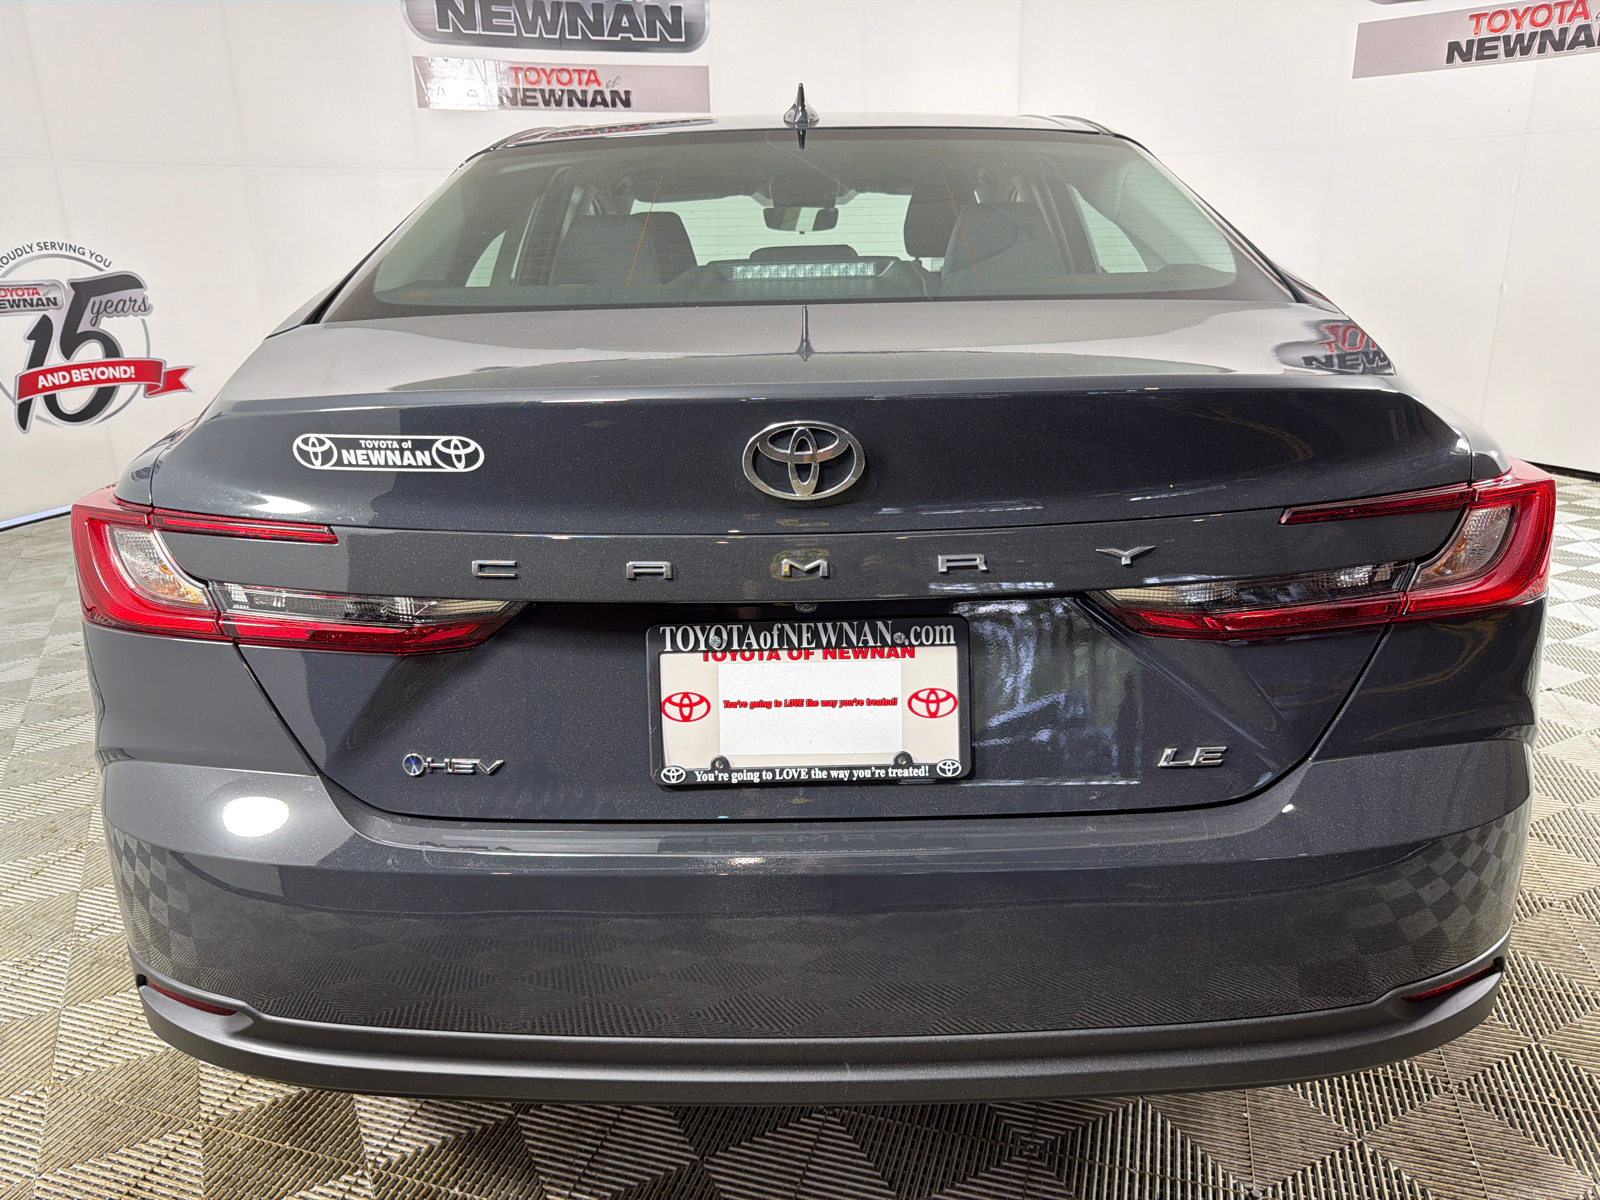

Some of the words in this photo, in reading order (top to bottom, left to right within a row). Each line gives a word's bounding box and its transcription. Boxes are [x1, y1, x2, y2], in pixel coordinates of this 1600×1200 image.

[434, 0, 686, 42] NEWNAN
[1469, 0, 1590, 35] TOYOTA
[1446, 23, 1600, 64] NEWNA
[509, 66, 601, 87] TOYOTA
[499, 87, 632, 109] NEWNAN
[0, 243, 34, 270] OUDLY
[36, 241, 86, 256] SERVING
[88, 250, 112, 268] YOU
[0, 287, 41, 298] OYOTA
[0, 297, 58, 309] EWNAN
[90, 297, 150, 328] years
[38, 374, 71, 389] AND
[72, 366, 136, 384] BEYOND!
[359, 440, 399, 449] TOYOTA
[401, 440, 412, 449] of
[341, 449, 432, 466] NEWNAN
[703, 650, 781, 662] TOYOTA
[787, 649, 814, 660] OF
[822, 646, 916, 660] NEWNAN
[723, 699, 748, 709] You're
[749, 699, 772, 710] going
[774, 699, 782, 708] to
[783, 698, 804, 708] LOVE
[805, 698, 819, 707] the
[820, 699, 838, 709] way
[839, 697, 864, 709] you're
[866, 697, 898, 707] treated!
[426, 757, 505, 775] HEV
[1157, 746, 1227, 767] LE
[694, 770, 729, 782] You're
[731, 769, 760, 784] going
[762, 769, 773, 780] to
[775, 767, 808, 780] LOVE
[811, 767, 828, 779] the
[830, 769, 850, 781] way
[852, 766, 886, 781] you're
[888, 765, 929, 777] treated!
